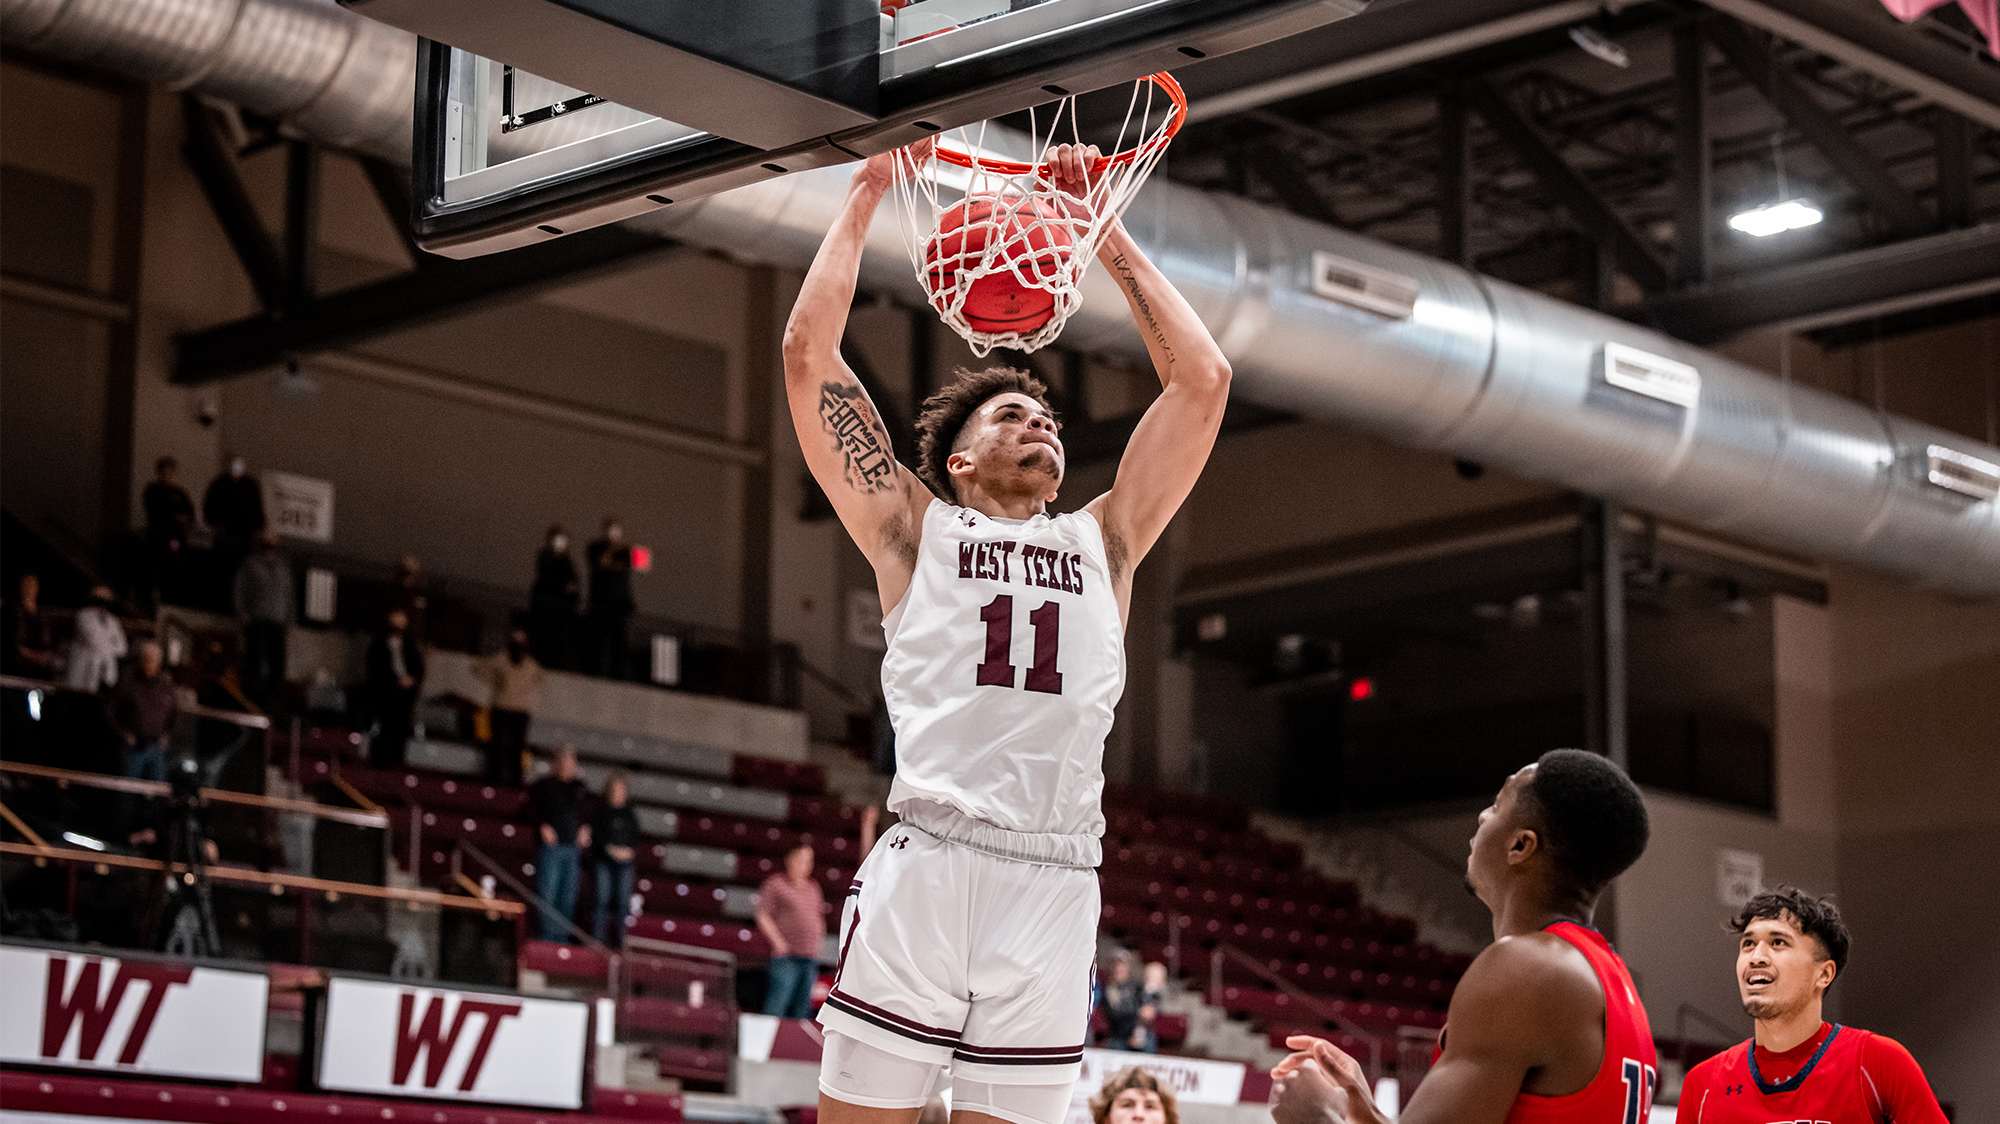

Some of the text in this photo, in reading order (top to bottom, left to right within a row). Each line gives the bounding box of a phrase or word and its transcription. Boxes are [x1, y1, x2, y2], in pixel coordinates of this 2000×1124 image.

[958, 541, 1084, 596] WEST TEXAS
[976, 594, 1063, 695] 11
[40, 952, 193, 1070] WT
[392, 988, 523, 1096] WT
